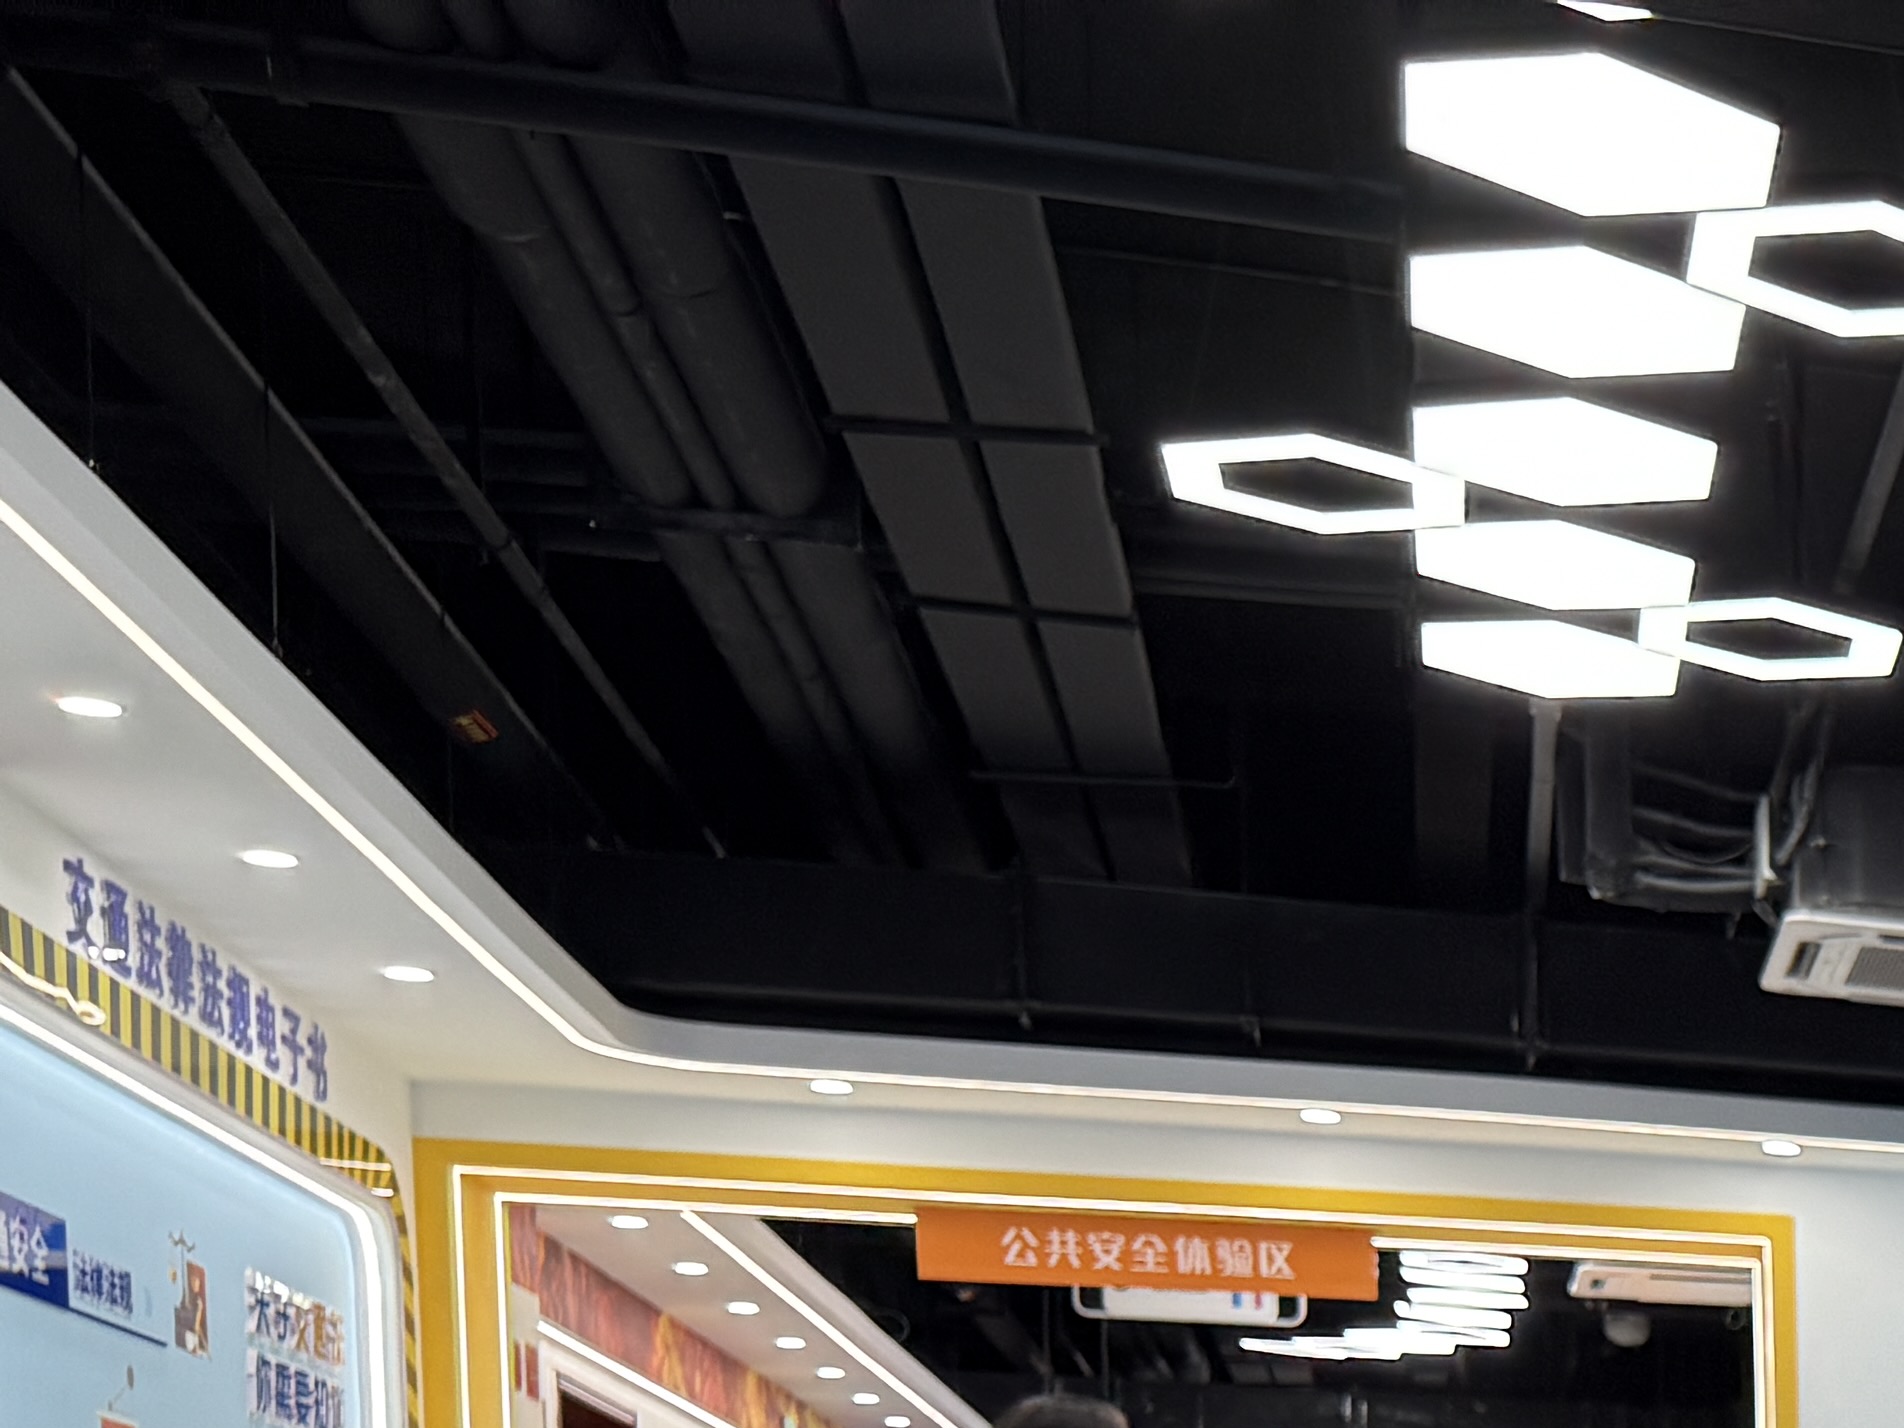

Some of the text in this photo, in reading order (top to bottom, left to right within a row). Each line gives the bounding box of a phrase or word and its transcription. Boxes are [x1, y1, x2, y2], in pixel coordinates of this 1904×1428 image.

[1000, 1226, 1297, 1281] 公共安全体验区
